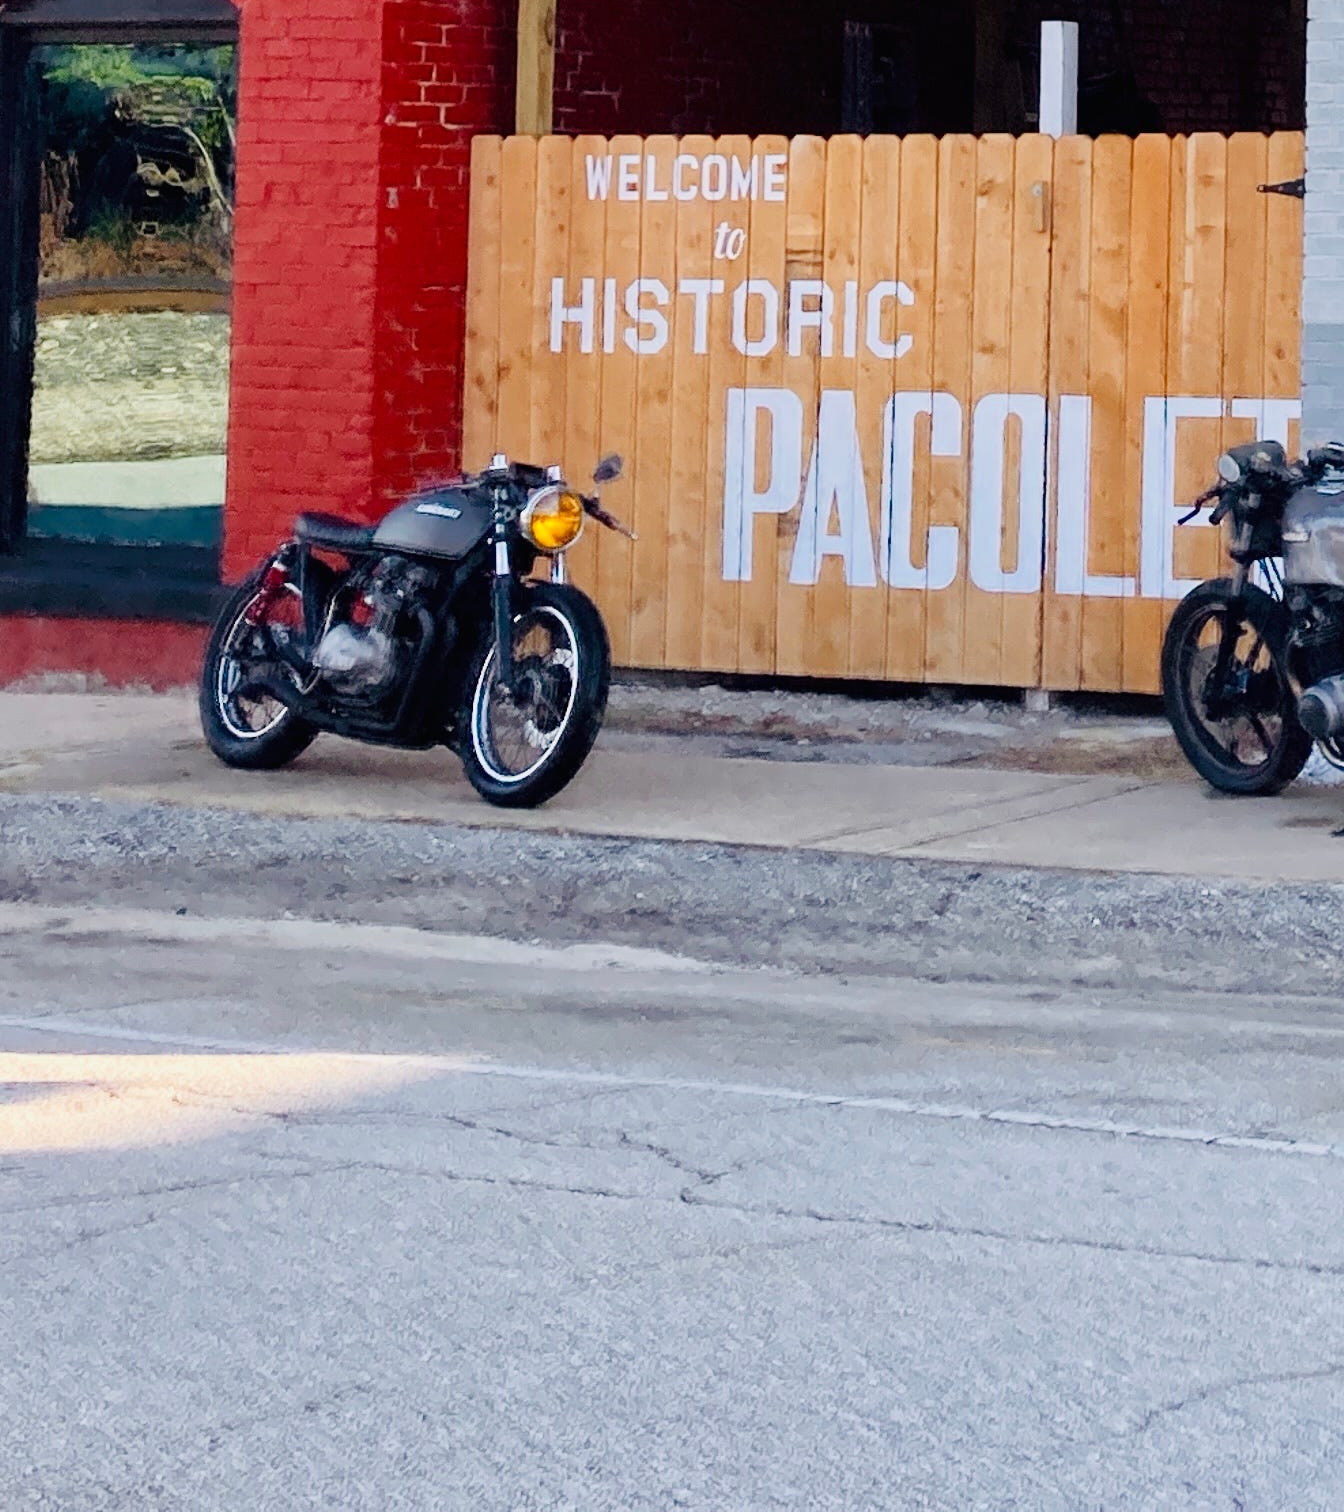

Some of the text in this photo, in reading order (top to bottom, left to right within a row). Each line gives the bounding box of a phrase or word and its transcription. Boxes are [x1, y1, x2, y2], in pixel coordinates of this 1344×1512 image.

[585, 153, 788, 203] WELCOME
[713, 220, 748, 261] to
[549, 275, 916, 361] HISTORIC
